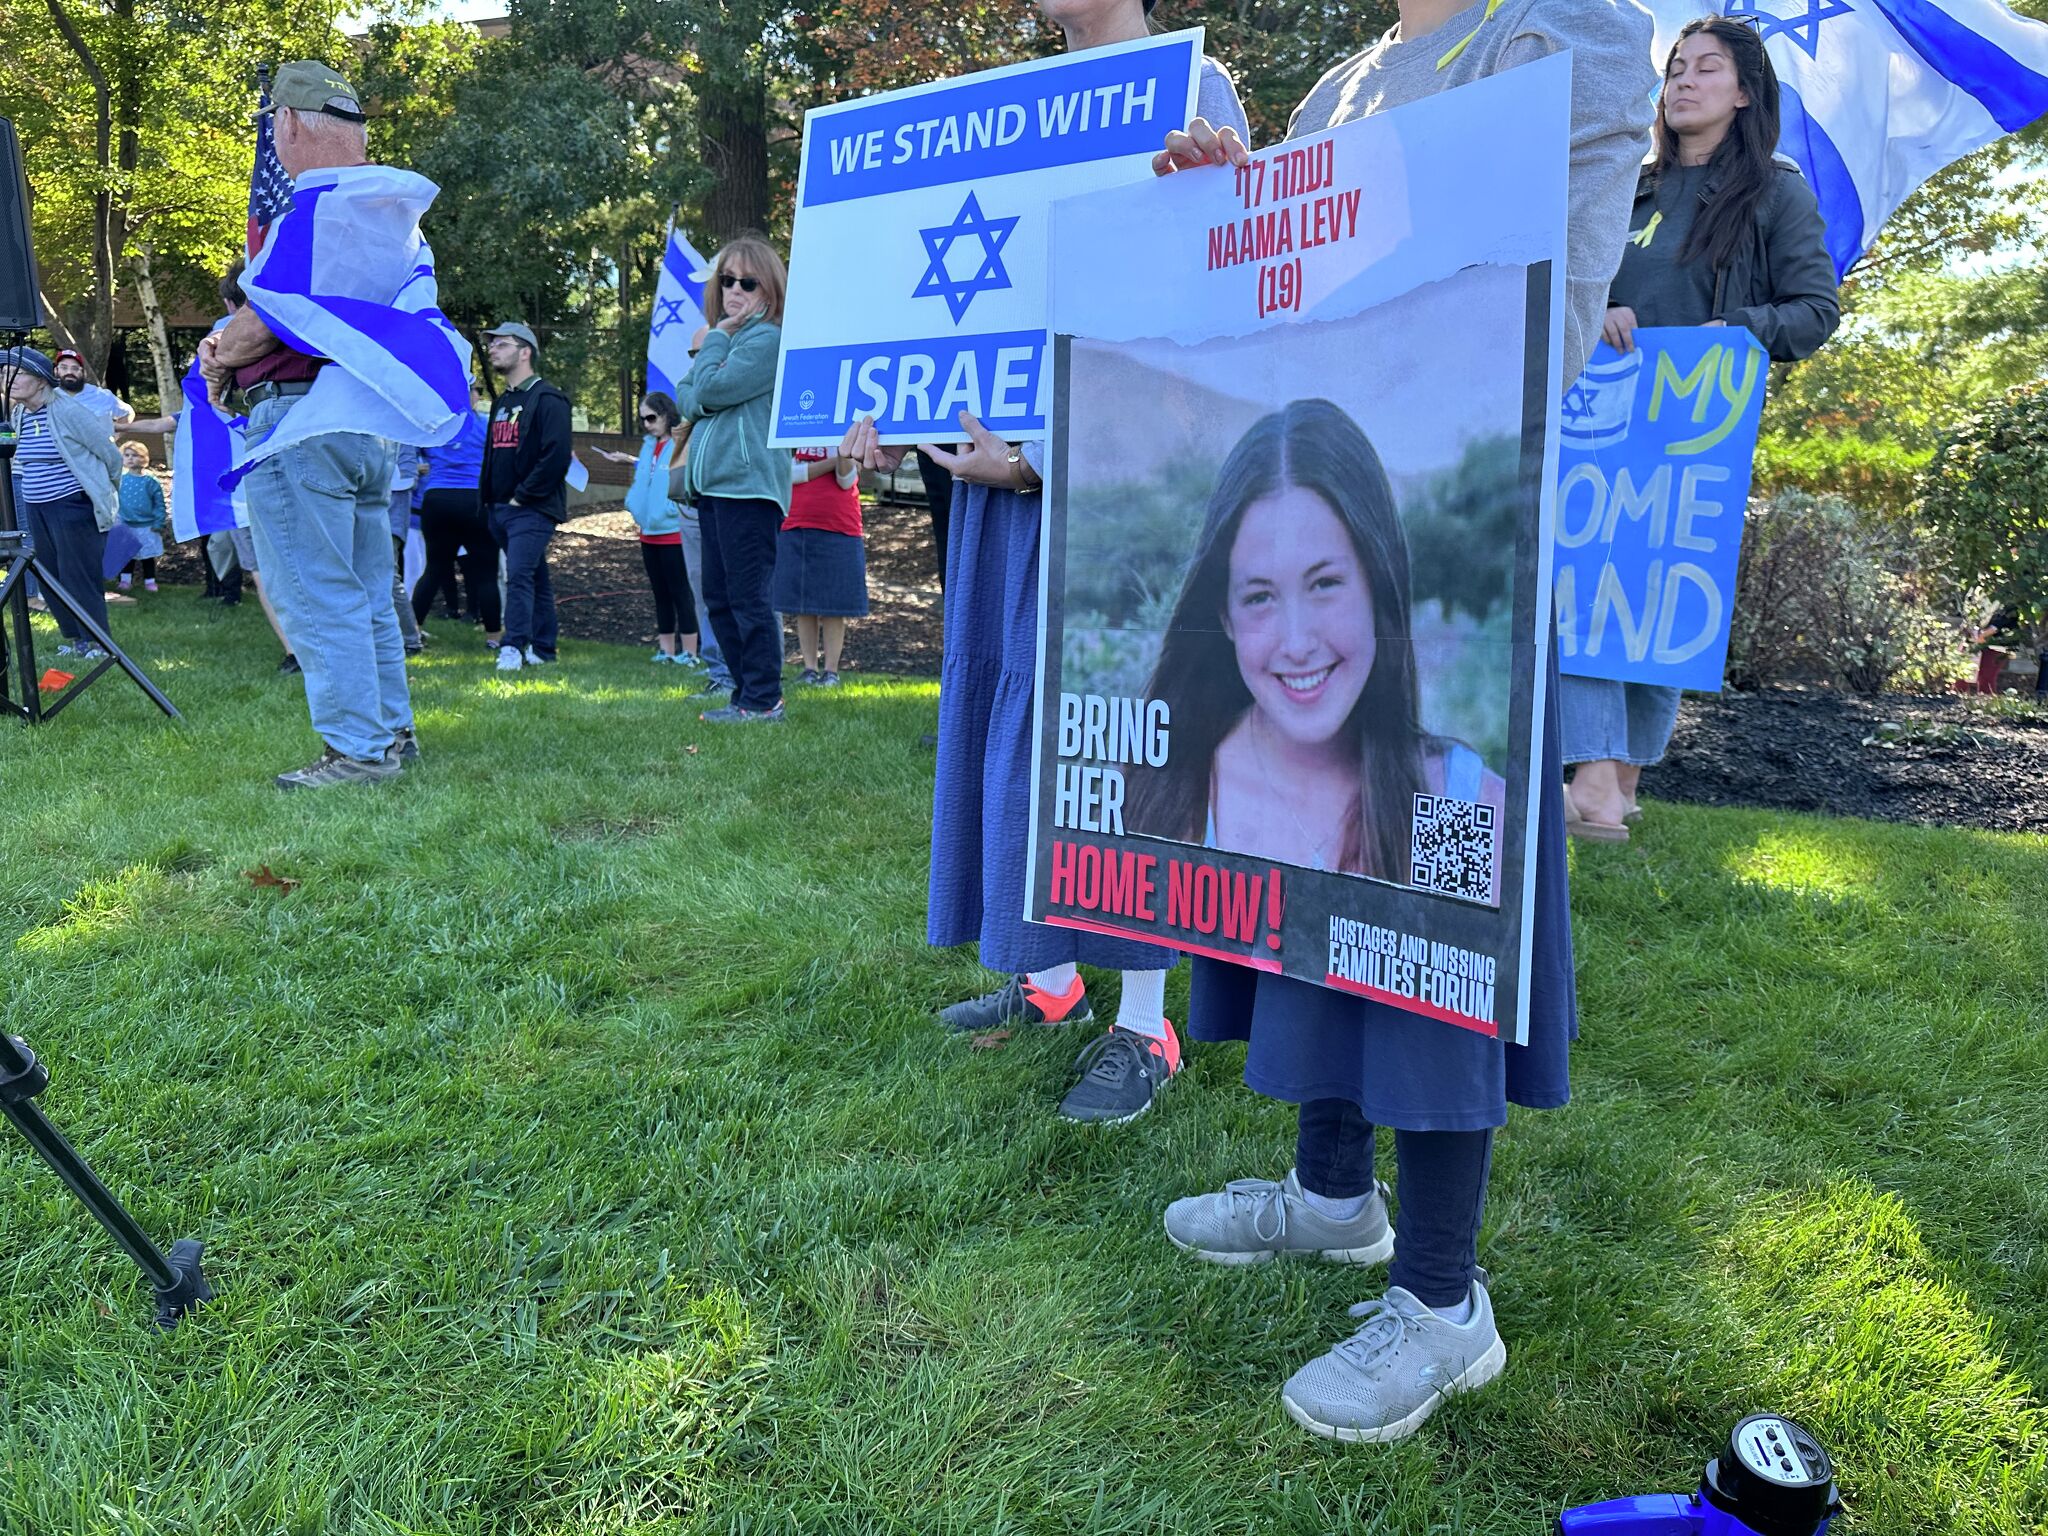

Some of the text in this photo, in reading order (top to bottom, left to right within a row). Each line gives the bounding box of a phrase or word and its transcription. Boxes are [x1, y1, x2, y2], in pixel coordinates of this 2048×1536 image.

[830, 78, 1157, 176] WE STAND WITH
[1234, 139, 1333, 209] נעמה לוי
[1207, 188, 1361, 271] NAAMA LEVY
[1258, 257, 1302, 319] (19)
[1555, 463, 1731, 552] OME
[1555, 559, 1723, 665] AND
[1057, 692, 1170, 768] BRING
[1054, 764, 1125, 836] HER
[1050, 840, 1284, 951] HOME NOW!
[1328, 940, 1495, 1025] FAMILIES FORUM
[1329, 914, 1496, 986] HOSTAGES AND MISSING
